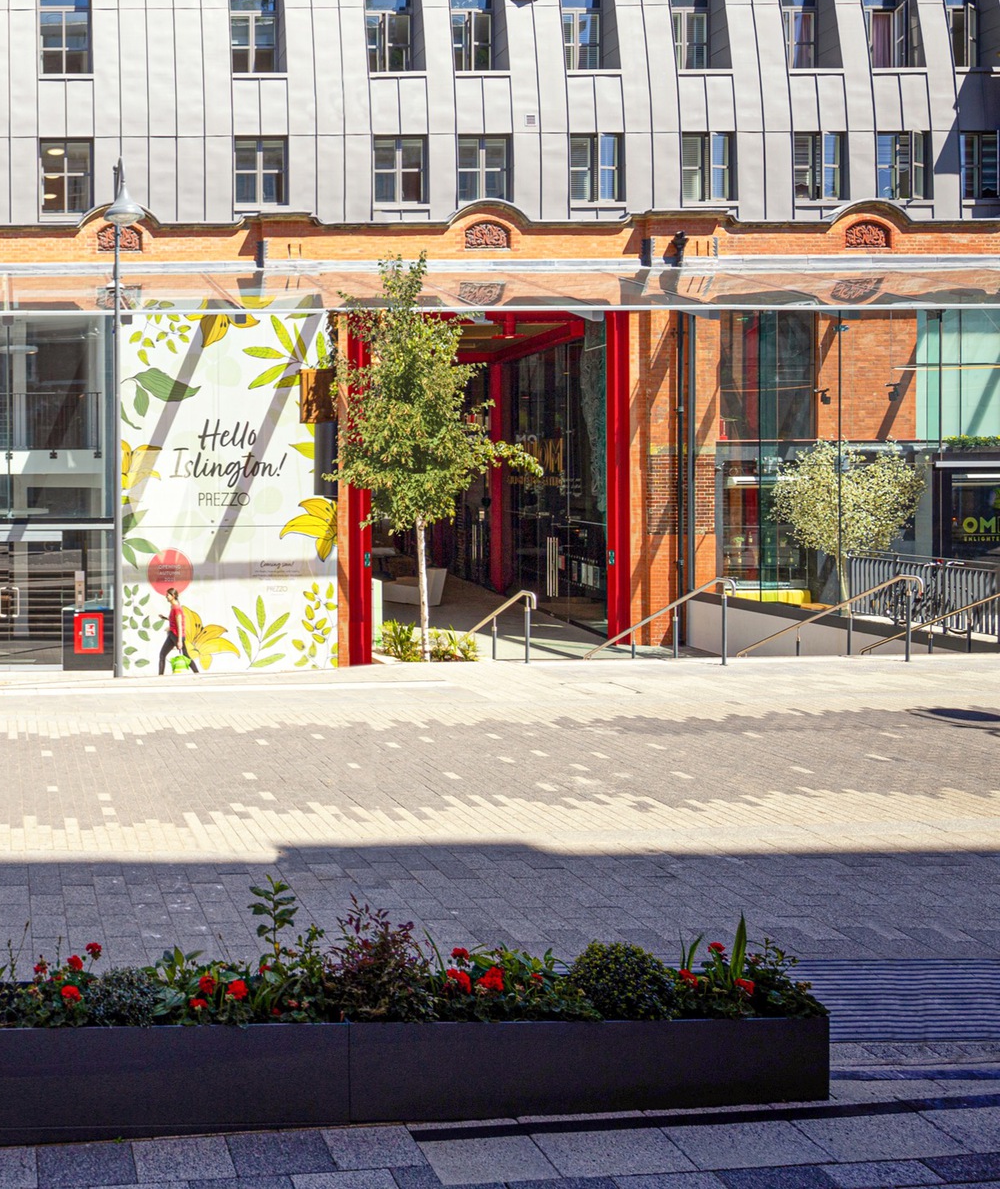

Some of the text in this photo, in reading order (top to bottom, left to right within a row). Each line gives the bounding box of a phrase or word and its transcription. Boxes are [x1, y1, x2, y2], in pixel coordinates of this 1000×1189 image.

[198, 418, 257, 451] Hello
[169, 447, 287, 488] Islington!
[198, 492, 251, 506] PREZZO
[260, 560, 281, 569] Coming
